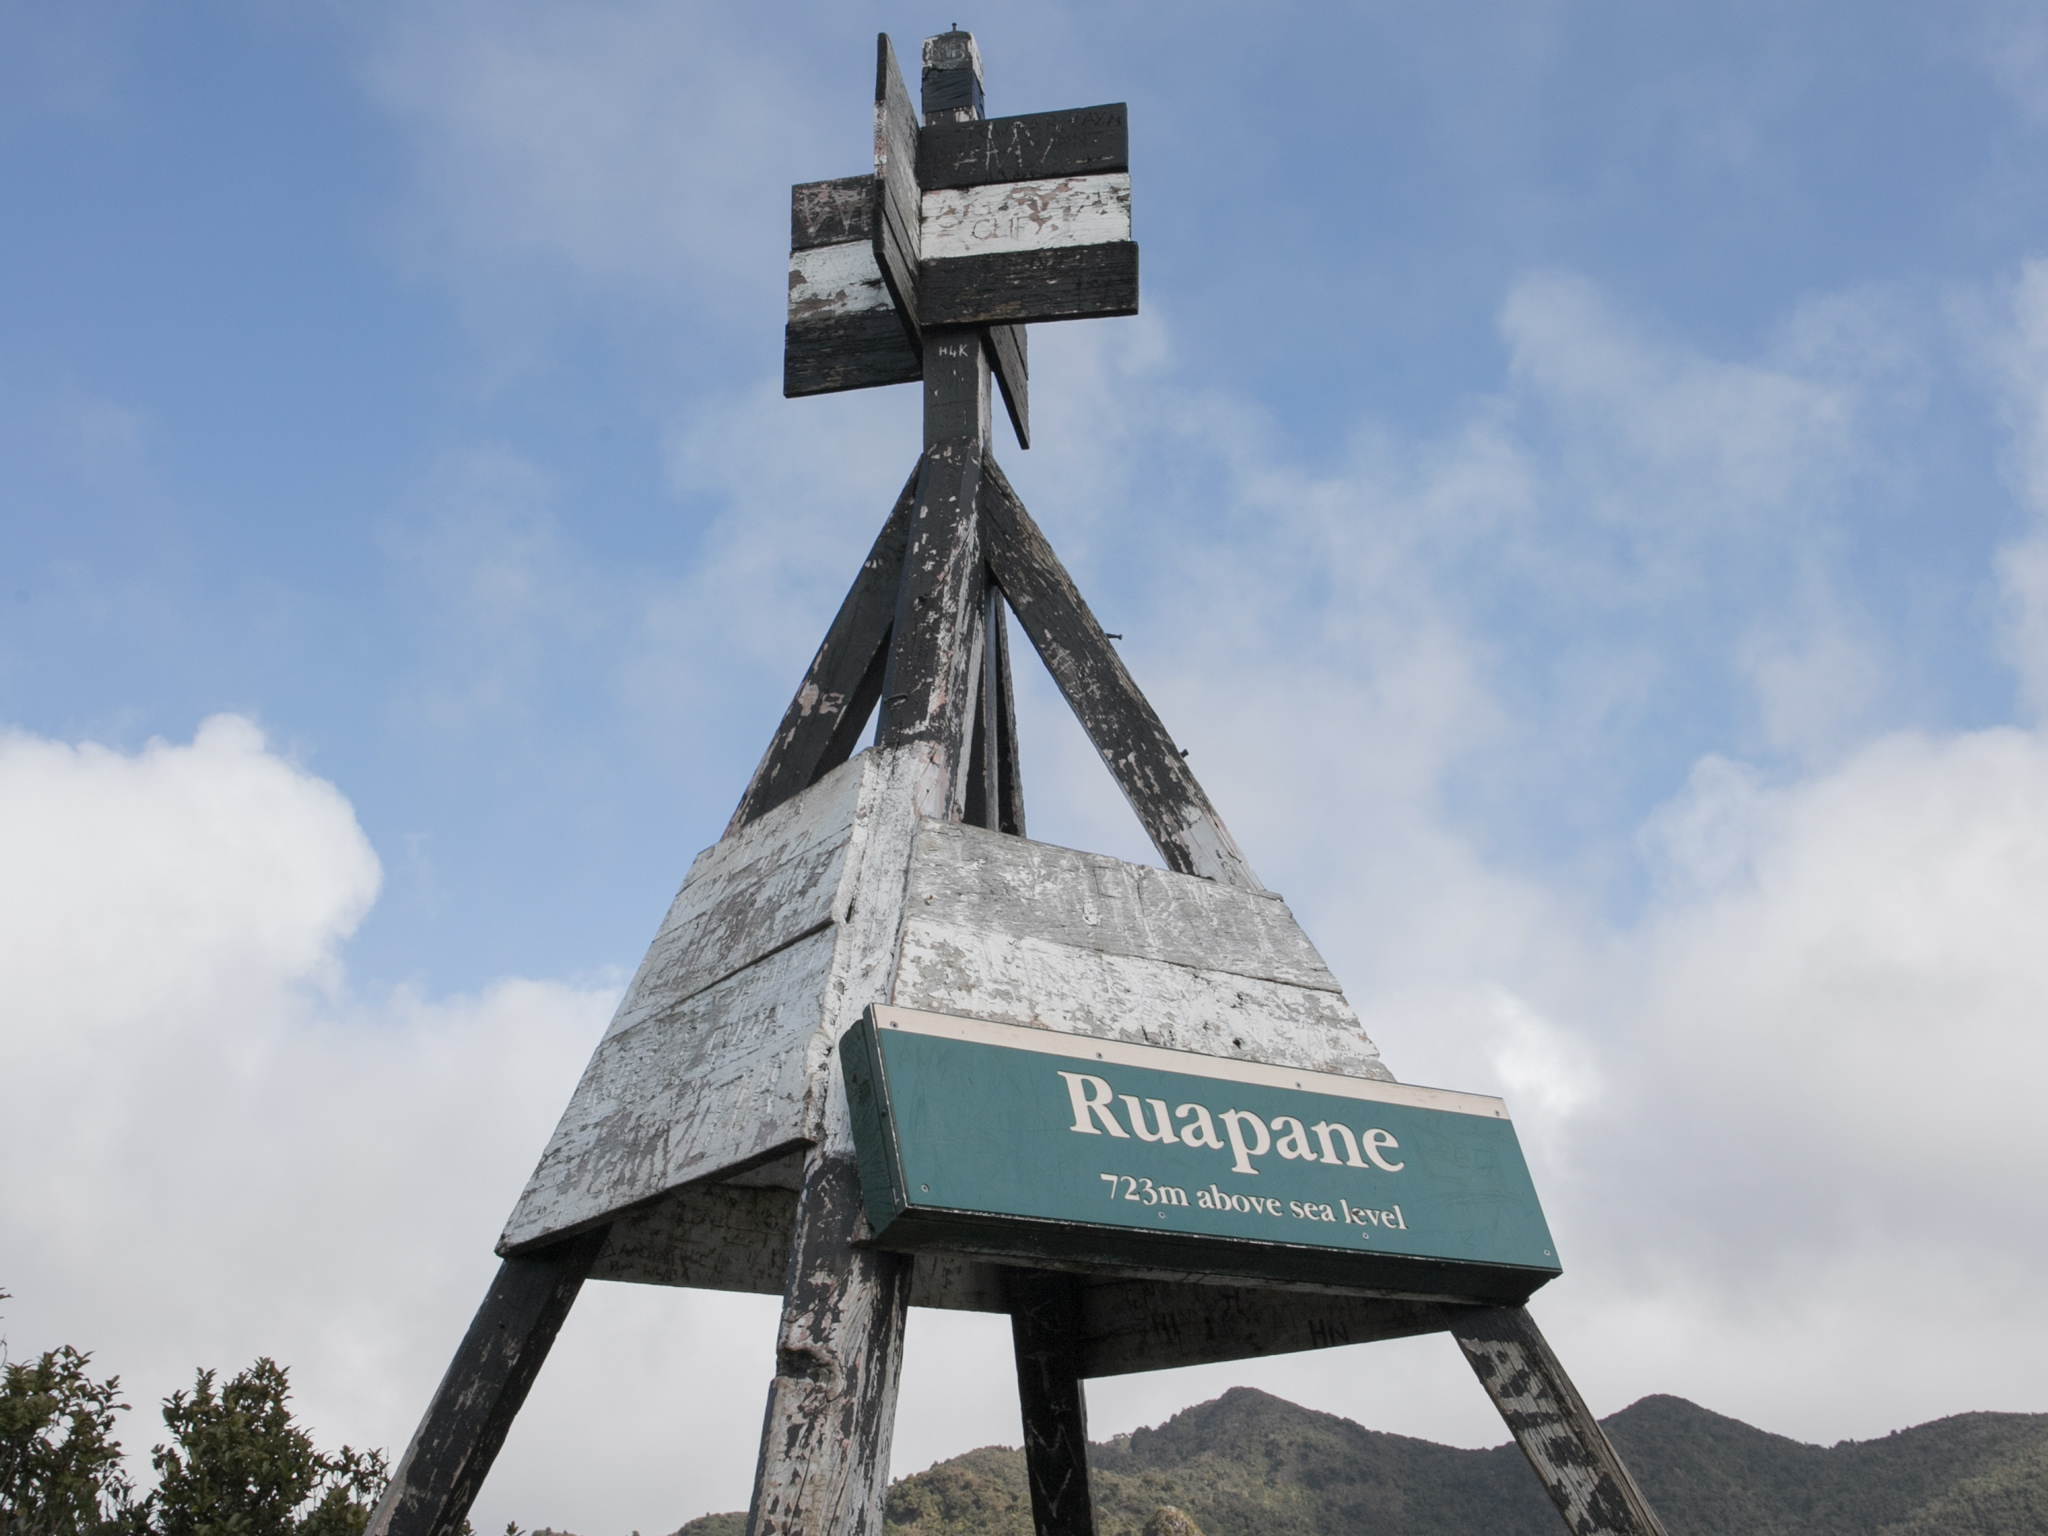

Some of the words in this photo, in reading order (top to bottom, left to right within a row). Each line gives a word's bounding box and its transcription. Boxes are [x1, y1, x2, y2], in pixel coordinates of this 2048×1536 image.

[1057, 1070, 1405, 1175] Ruapane
[1100, 1173, 1190, 1207] 723m
[1196, 1184, 1284, 1217] above
[1289, 1200, 1336, 1222] sea
[1339, 1198, 1408, 1230] level
